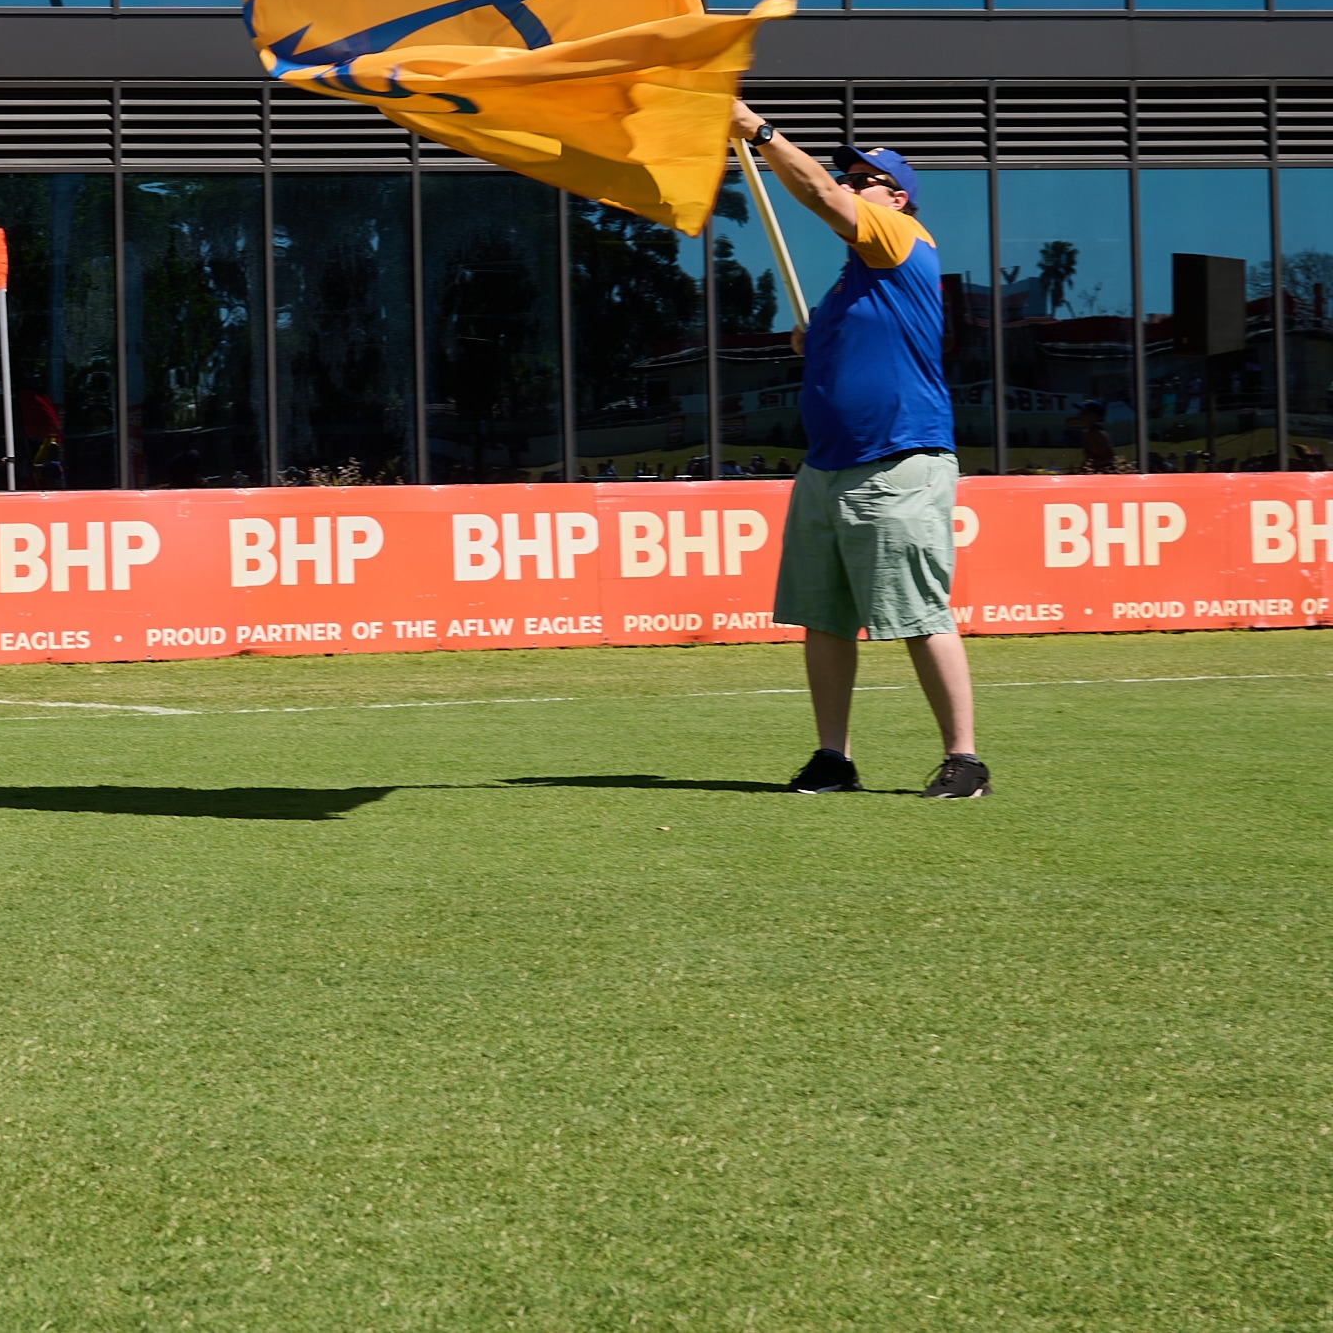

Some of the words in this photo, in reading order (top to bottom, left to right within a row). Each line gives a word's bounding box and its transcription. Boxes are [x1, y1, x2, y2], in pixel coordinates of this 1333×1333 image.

[229, 515, 384, 588] BHP
[452, 512, 599, 582] BHP
[618, 509, 769, 578] BHP
[1044, 502, 1186, 567] BHP
[1250, 500, 1333, 564] BH
[0, 630, 90, 651] EAGLES
[146, 627, 227, 647] PROUD
[236, 623, 341, 643] PARTNER
[352, 621, 382, 640] OF
[392, 620, 436, 638] THE
[447, 618, 514, 637] AFLW
[524, 615, 602, 635] EAGLES
[624, 613, 702, 633] PROUD
[712, 611, 785, 631] PARTN
[984, 604, 1063, 623] EAGLES
[1113, 601, 1184, 619] PROUD
[1194, 598, 1293, 617] PARTNER
[1301, 597, 1329, 616] OF
